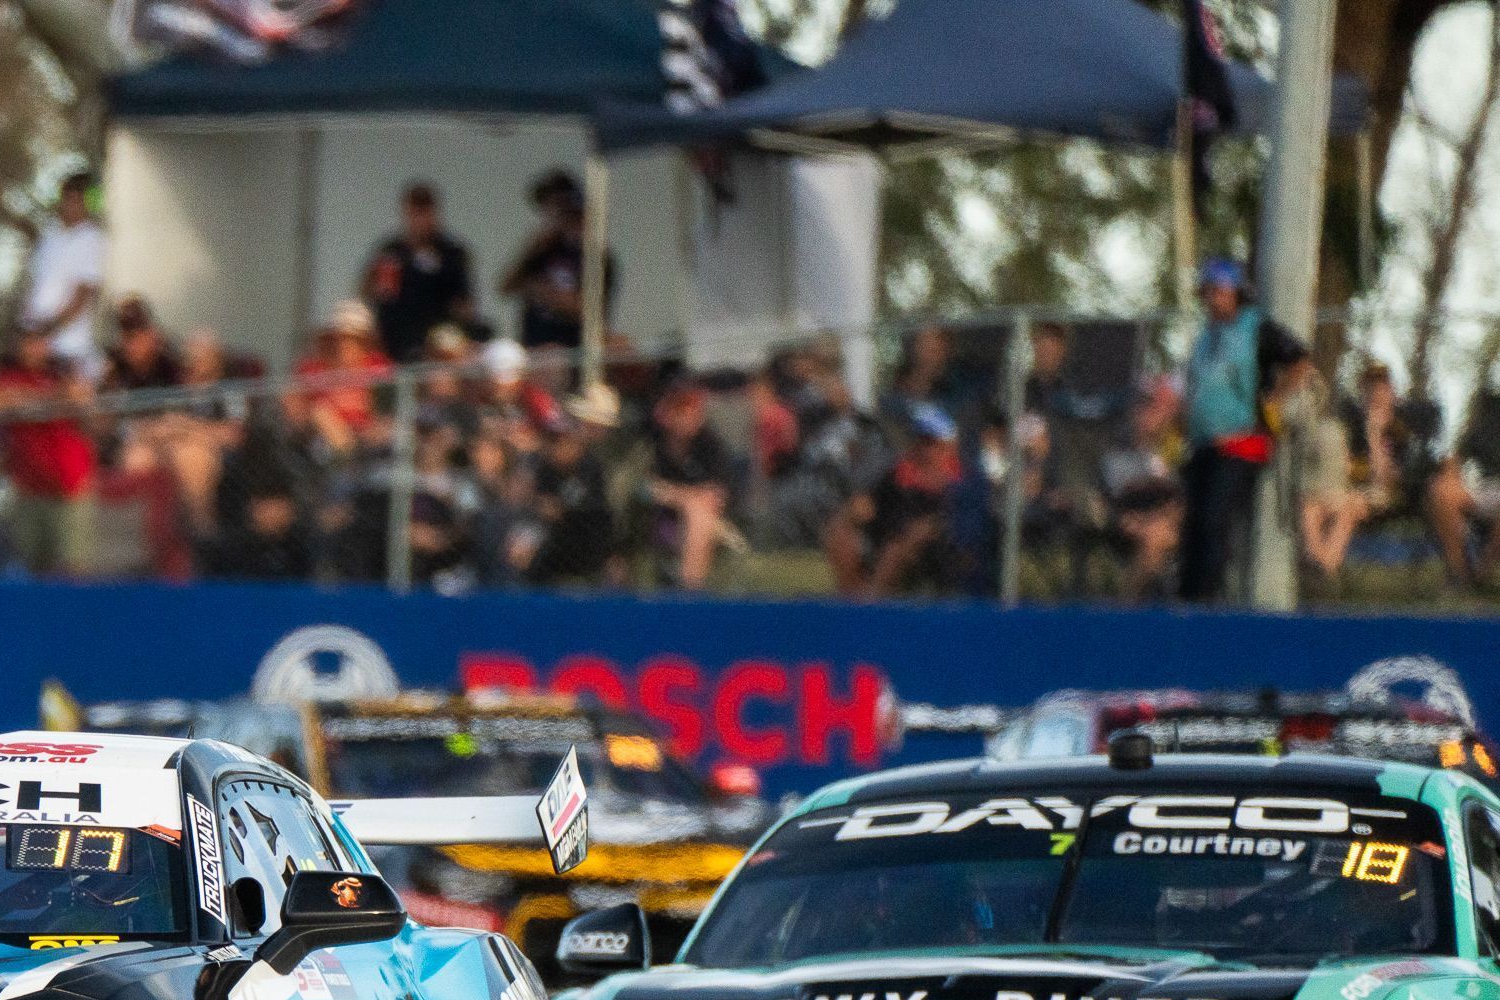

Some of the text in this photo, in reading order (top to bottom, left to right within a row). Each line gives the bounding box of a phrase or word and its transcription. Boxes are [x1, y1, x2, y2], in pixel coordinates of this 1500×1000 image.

[835, 796, 1349, 841] DAYCO
[195, 803, 221, 916] TRUCKMATE
[1049, 833, 1077, 856] 7
[1113, 831, 1307, 861] Courtney
[1341, 841, 1410, 884] 18
